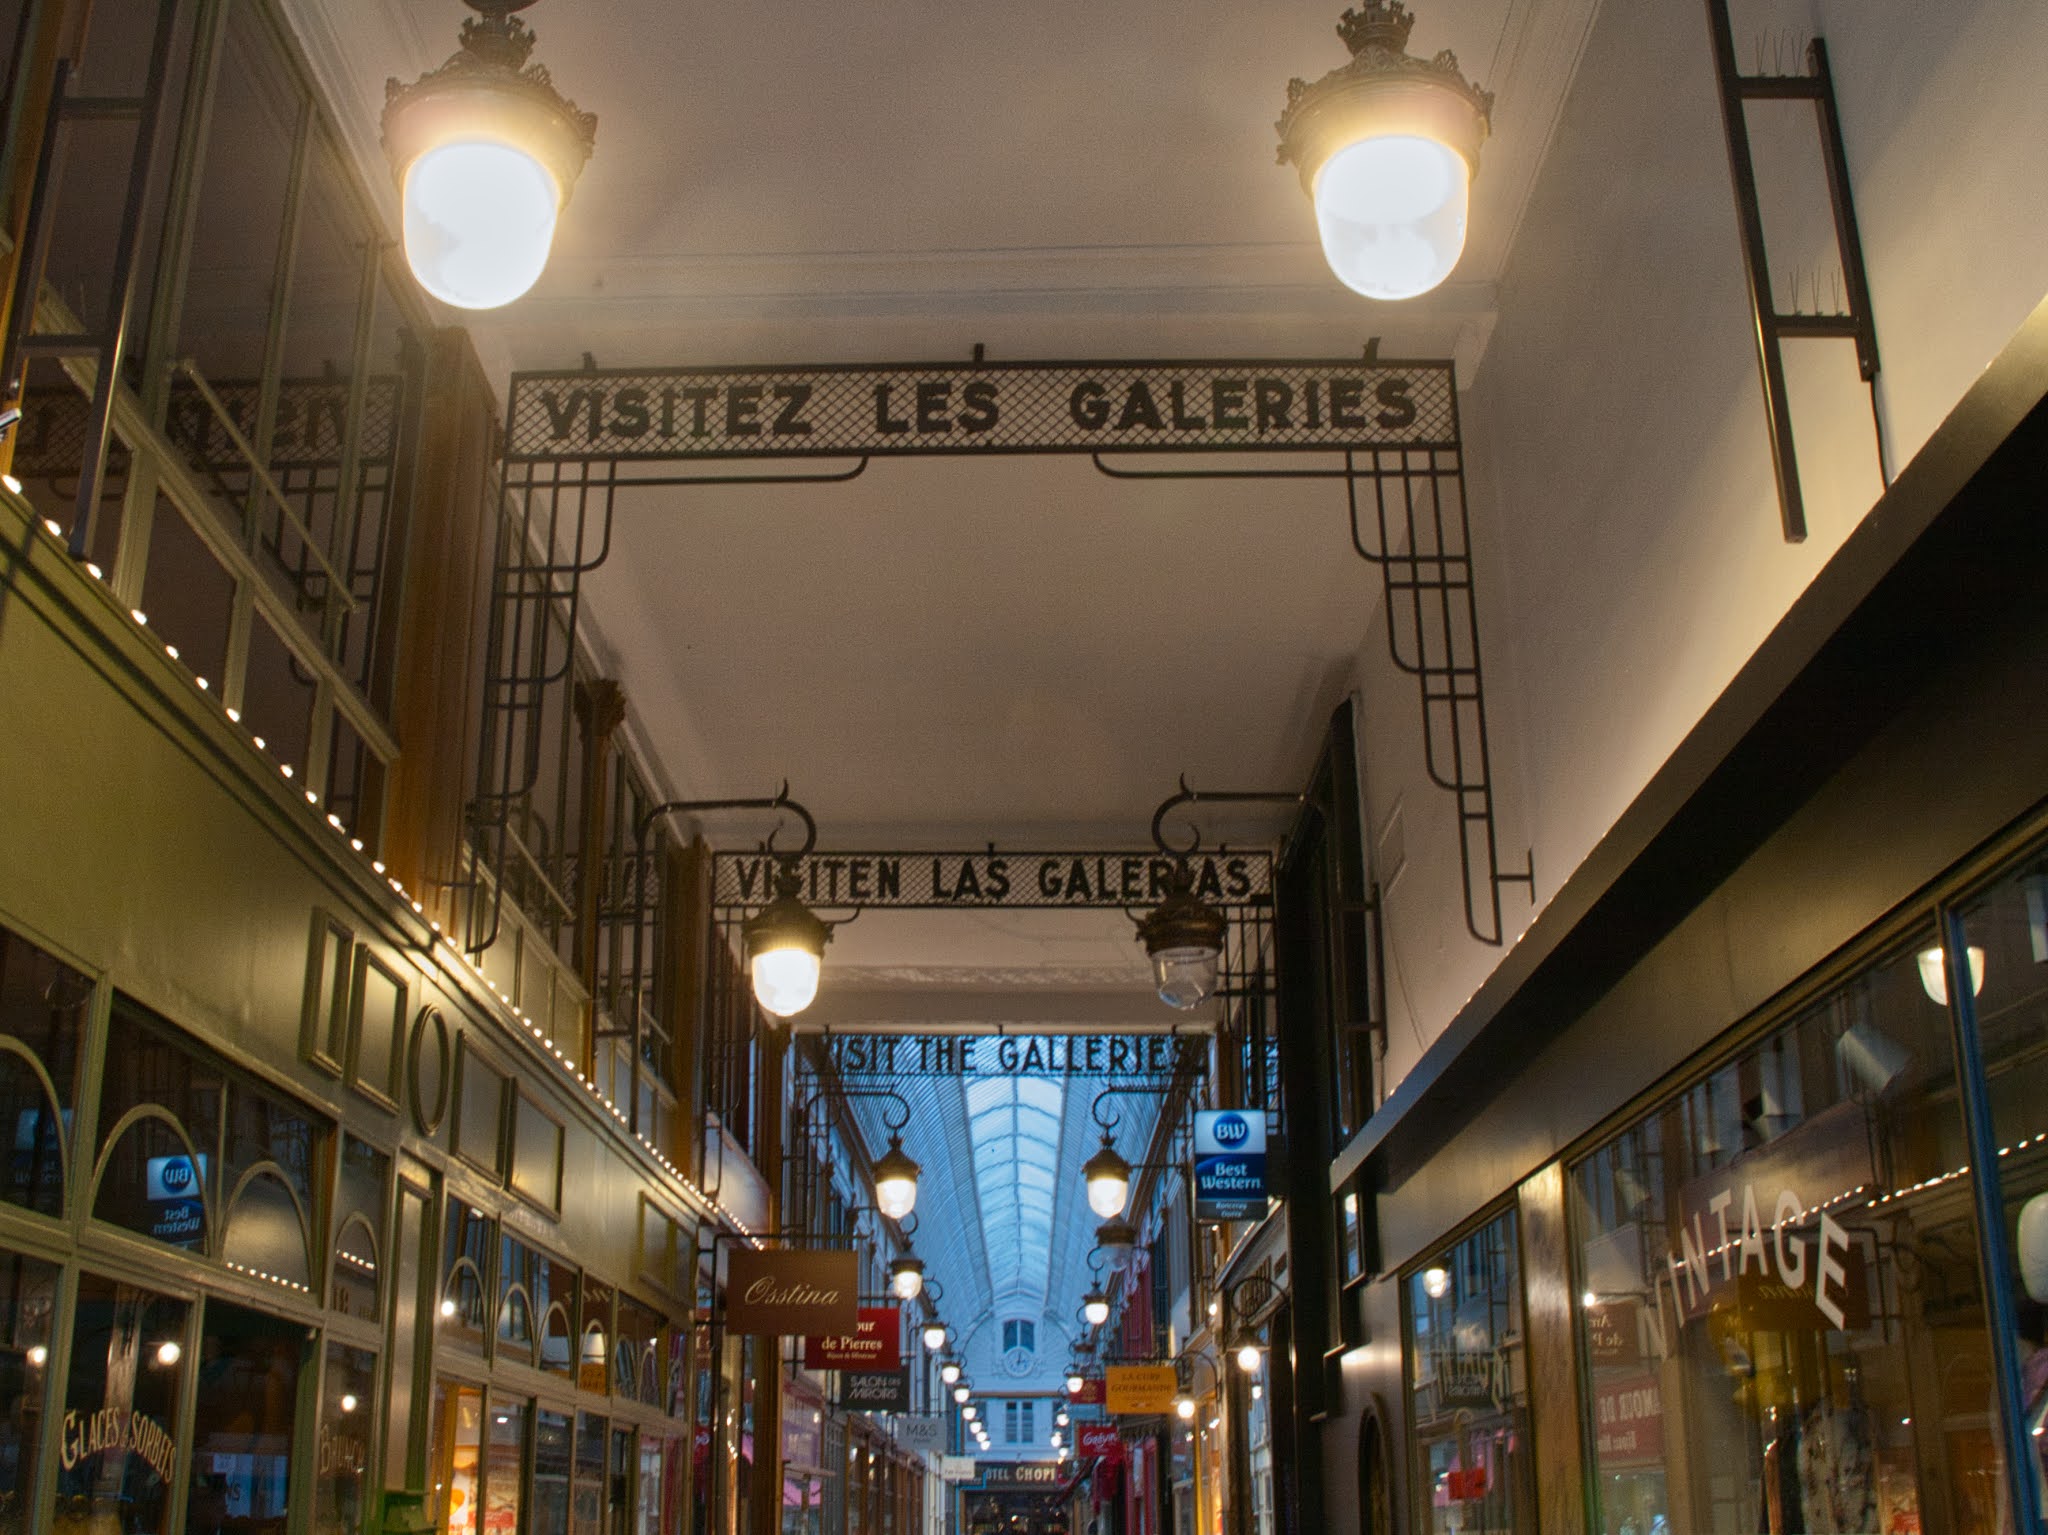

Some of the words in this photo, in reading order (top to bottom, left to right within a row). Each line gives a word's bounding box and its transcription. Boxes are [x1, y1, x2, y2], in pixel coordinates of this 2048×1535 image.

[540, 383, 813, 442] VISITEZ
[872, 380, 1000, 435] LES
[1068, 378, 1418, 432] GALERIES
[736, 858, 900, 899] VIITEN
[932, 858, 1011, 897] LAS
[1037, 857, 1252, 898] GALERAS
[915, 1036, 978, 1072] THE
[1215, 1122, 1246, 1140] BW
[1215, 1161, 1248, 1177] Best
[1200, 1175, 1262, 1190] Western
[821, 1336, 837, 1350] de
[839, 1336, 883, 1351] Pierres
[850, 1376, 887, 1387] SALON
[848, 1387, 898, 1400] MIROIRS
[60, 1407, 120, 1471] GLACES
[130, 1408, 177, 1484] SORBETS
